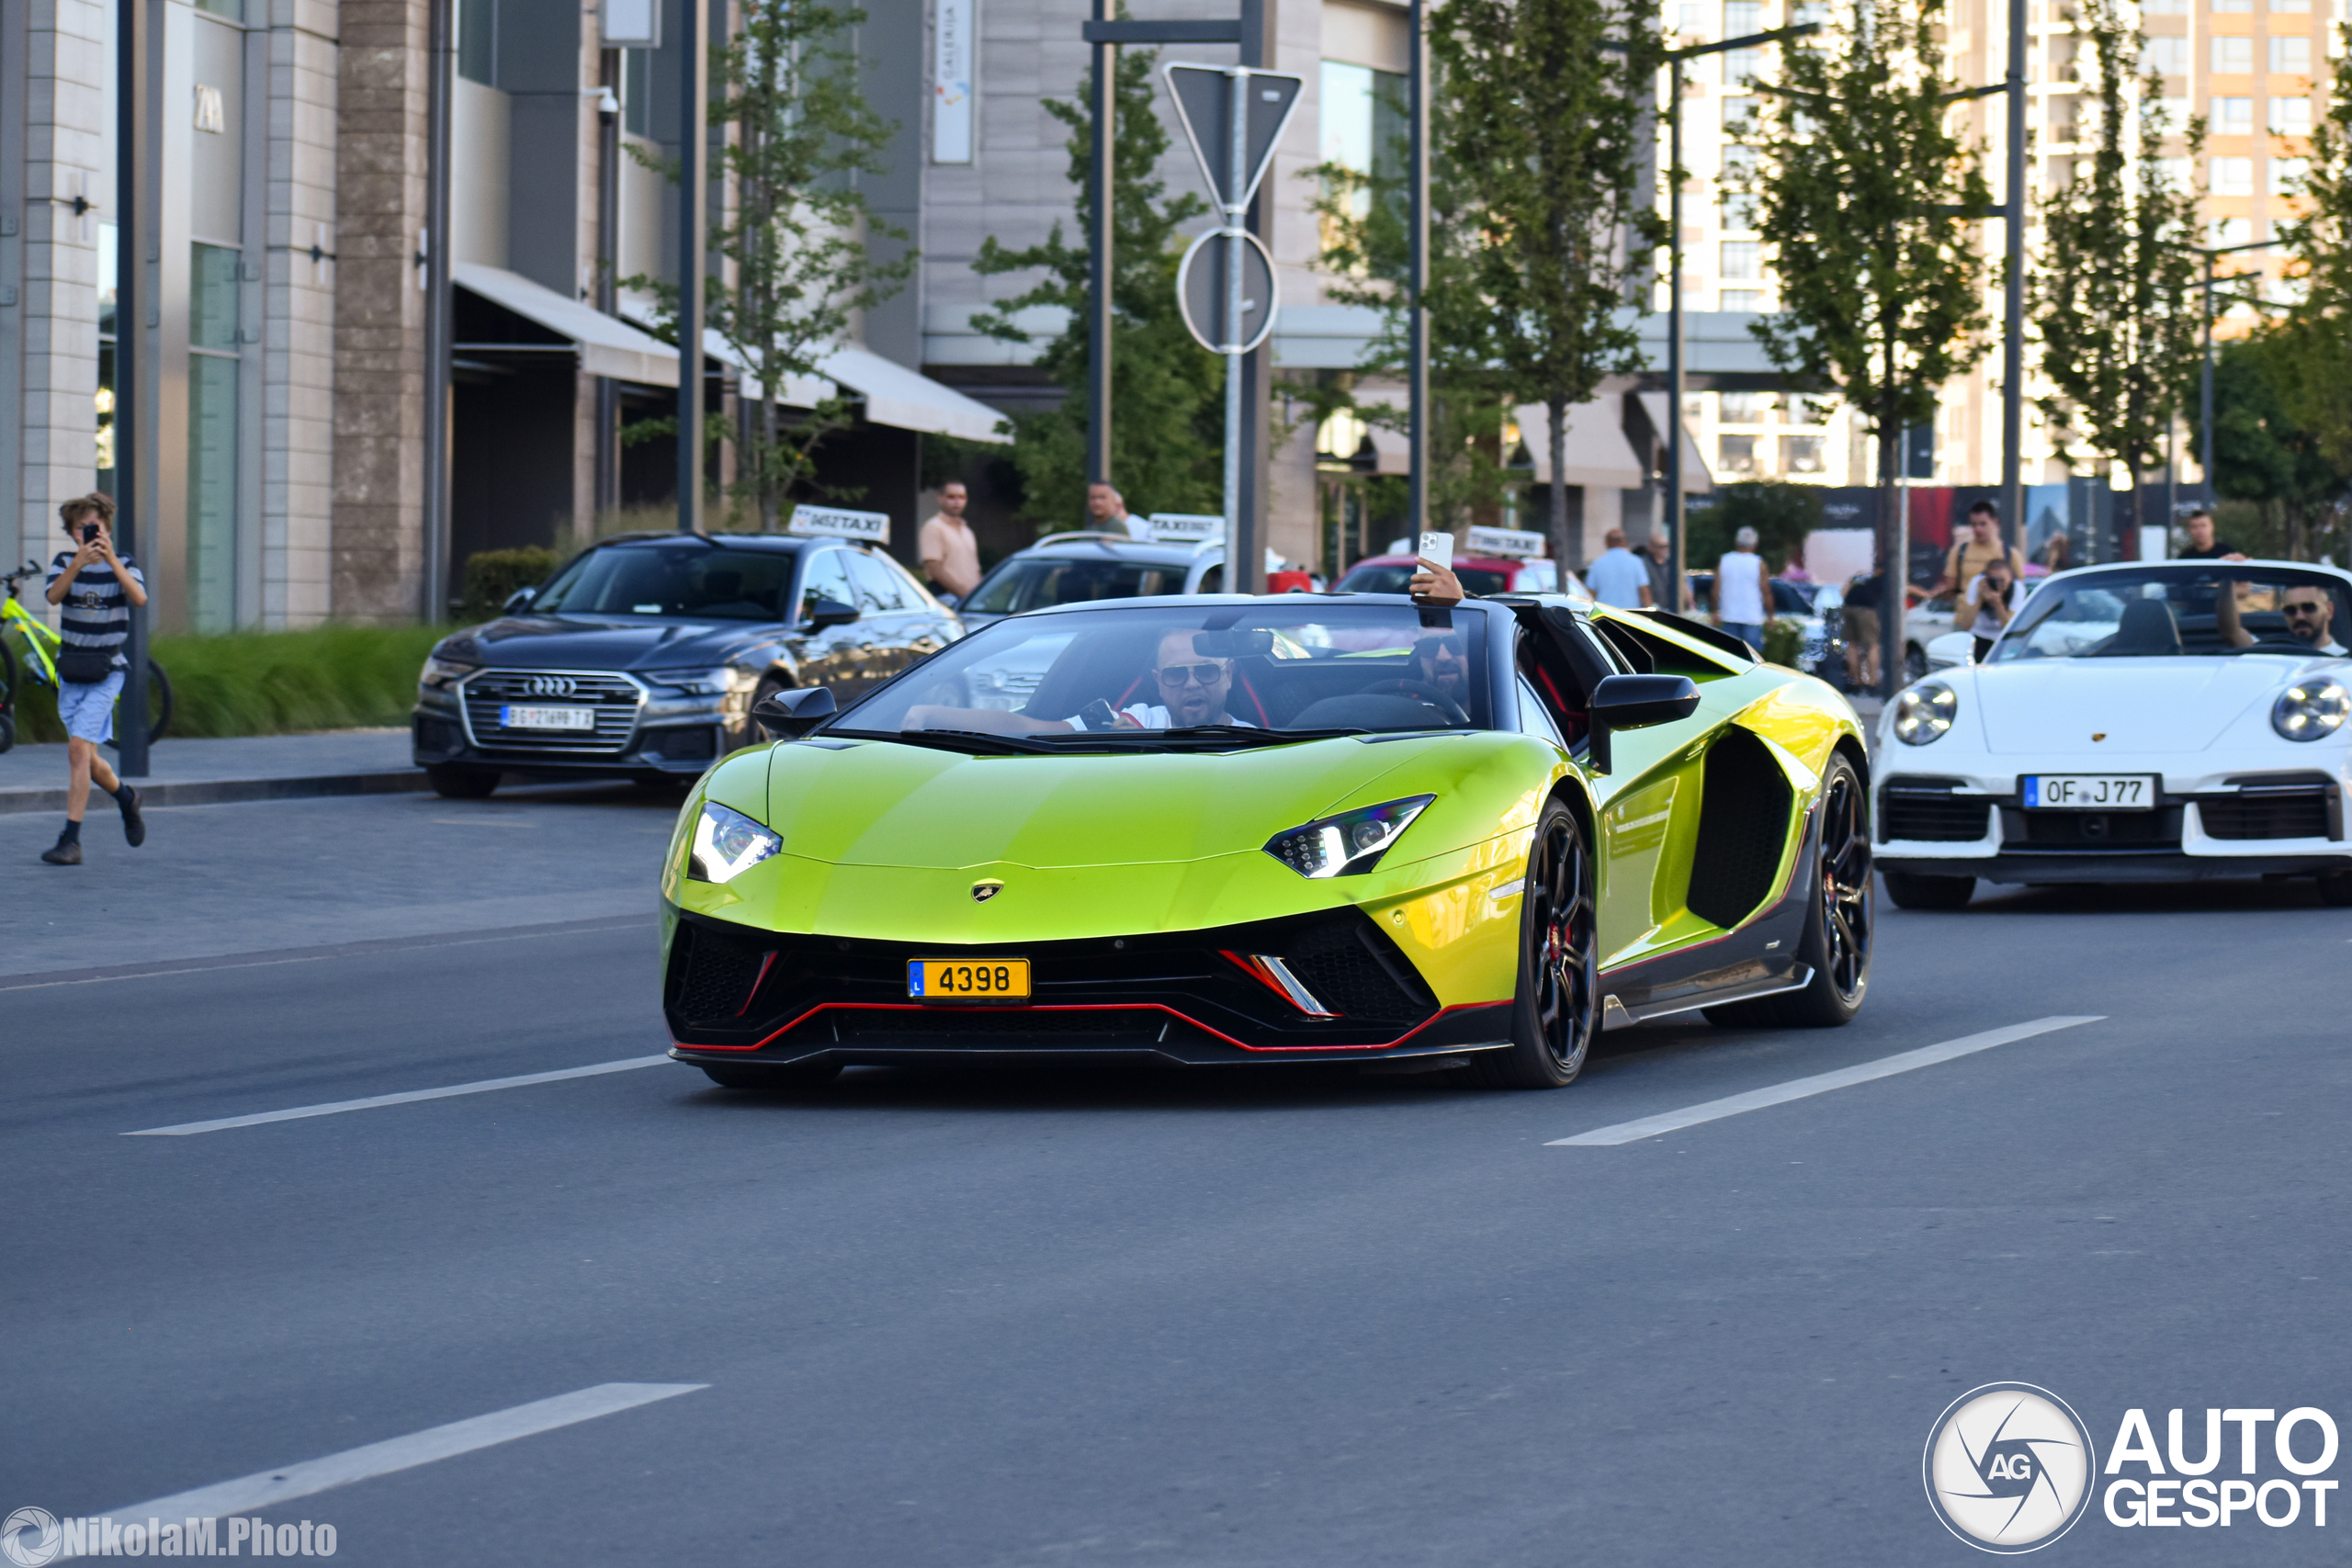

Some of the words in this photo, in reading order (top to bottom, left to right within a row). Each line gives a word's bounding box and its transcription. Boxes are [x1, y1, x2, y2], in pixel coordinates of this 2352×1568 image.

[942, 6, 956, 80] GALERIJA
[842, 517, 881, 533] TAXI
[1153, 520, 1188, 531] TAXI
[2048, 781, 2076, 802] OF
[913, 981, 921, 991] L
[939, 965, 1010, 992] 4398
